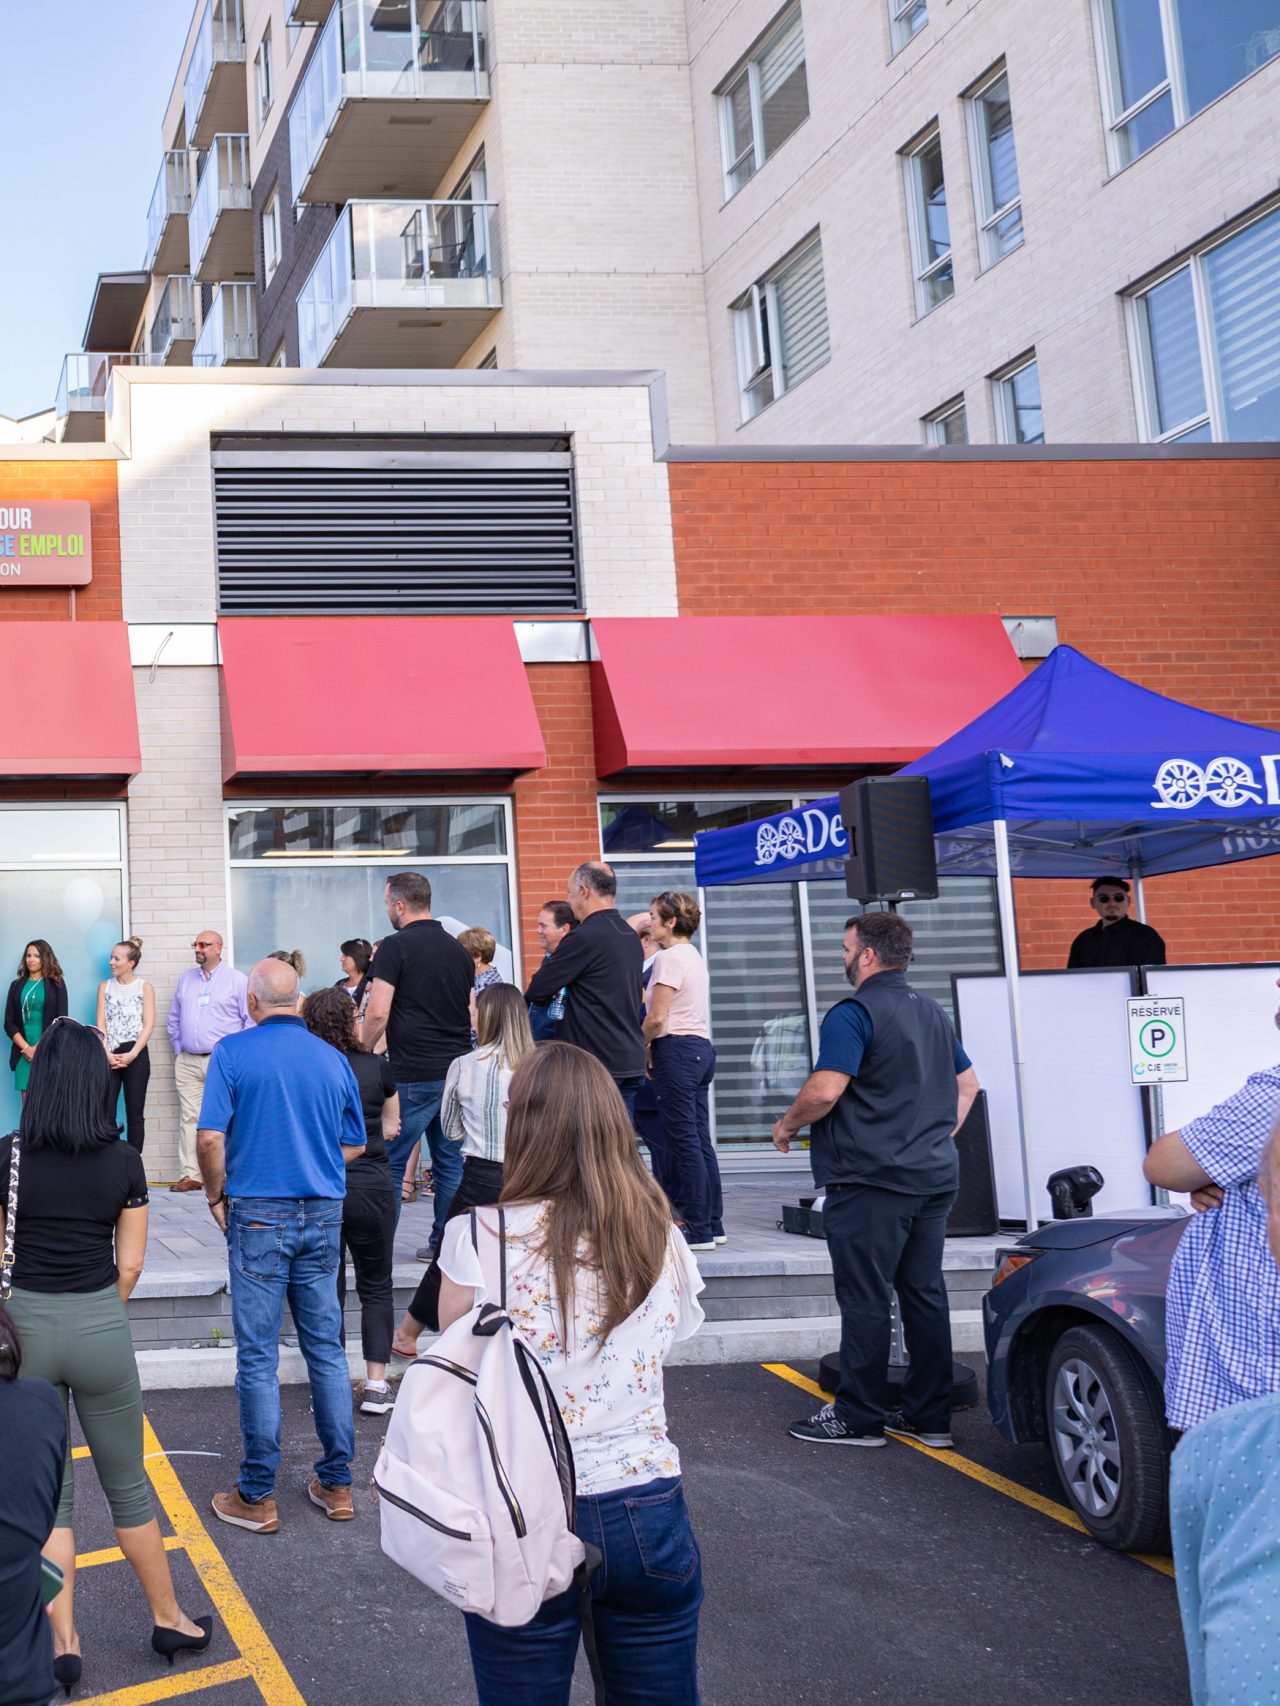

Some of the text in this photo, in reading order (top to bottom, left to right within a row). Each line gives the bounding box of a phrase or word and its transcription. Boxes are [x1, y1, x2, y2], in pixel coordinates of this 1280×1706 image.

[19, 534, 84, 557] EMPLOI
[1131, 1004, 1181, 1016] RÉSERVÉ
[1151, 1029, 1165, 1048] P
[1148, 1064, 1162, 1072] CJE
